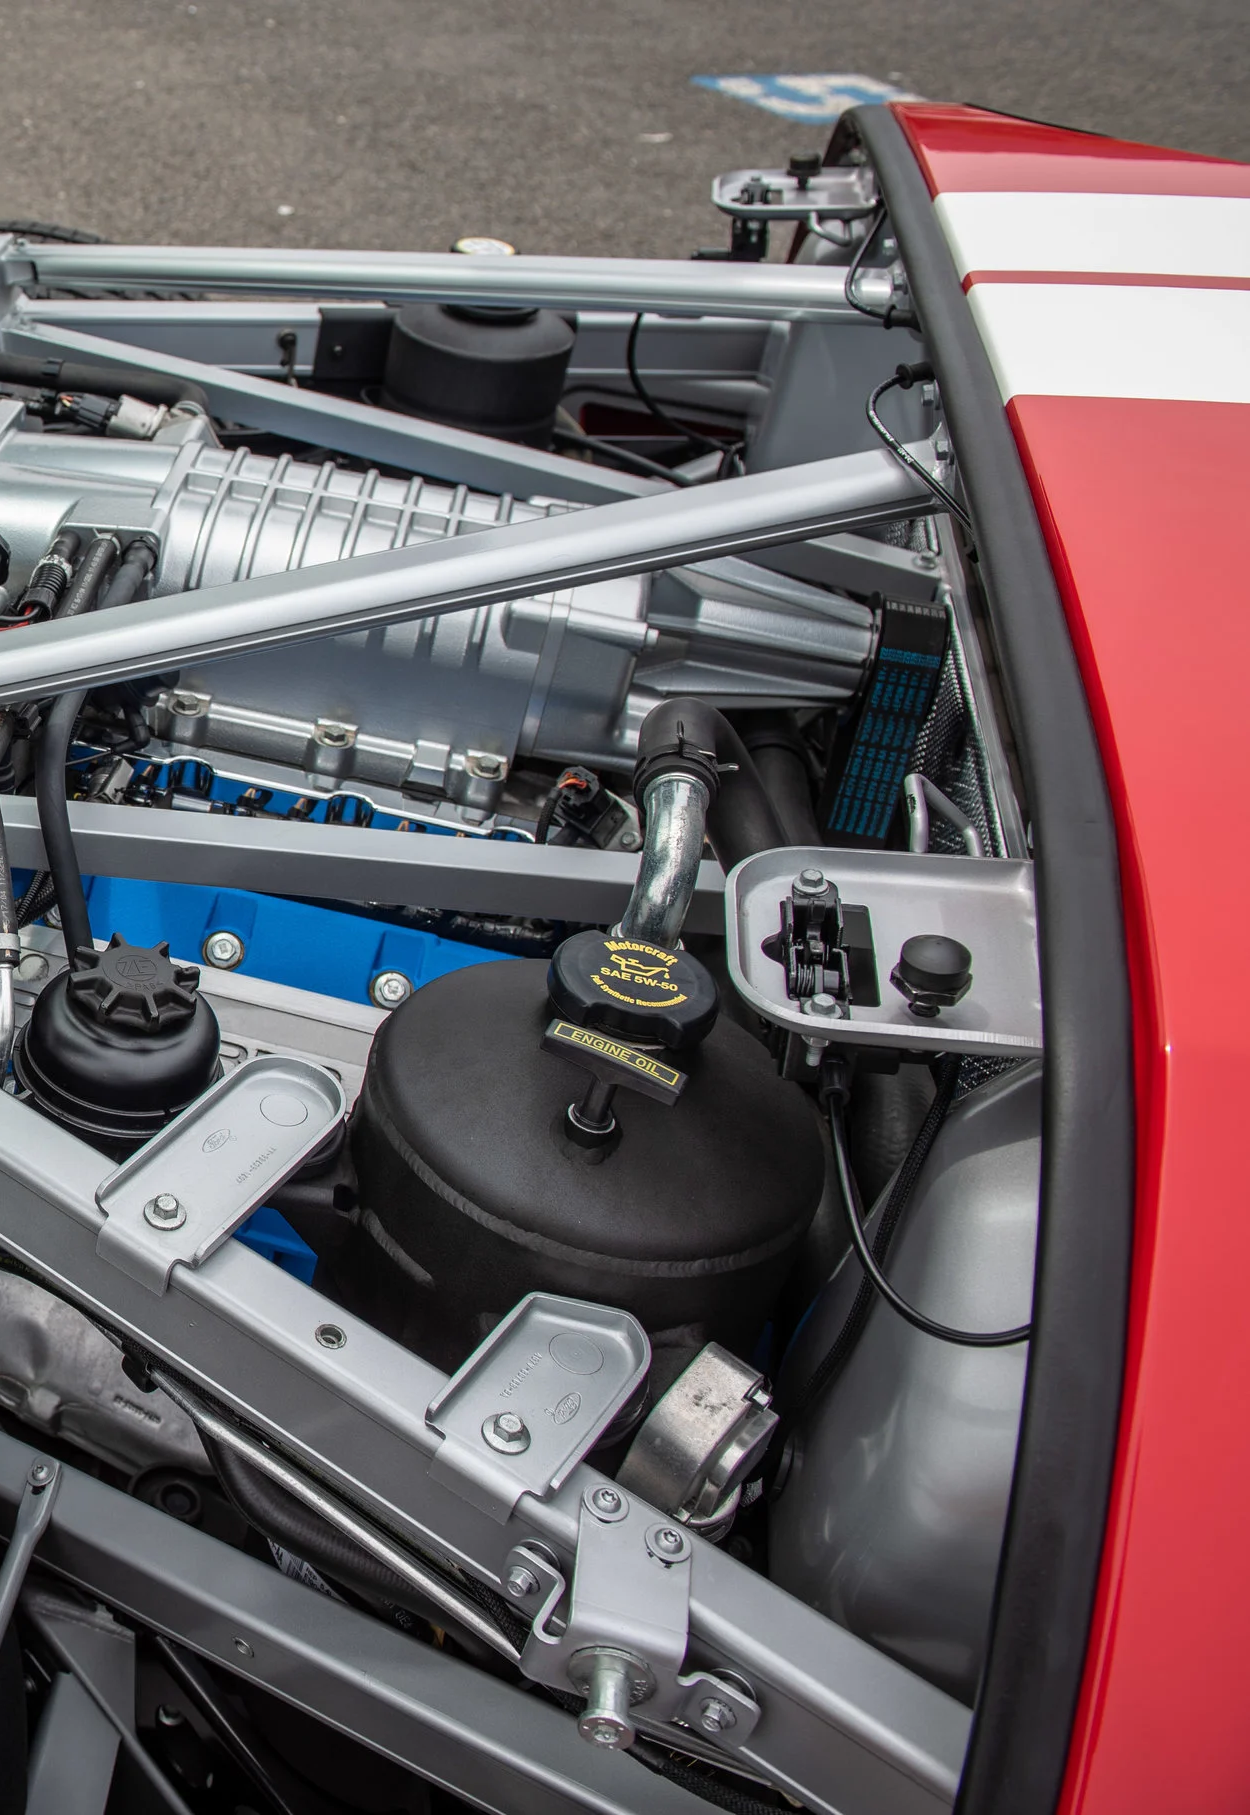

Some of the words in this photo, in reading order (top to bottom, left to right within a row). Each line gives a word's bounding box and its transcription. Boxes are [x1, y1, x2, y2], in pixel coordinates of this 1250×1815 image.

[604, 941, 678, 966] Motorcraft
[600, 967, 631, 981] SAE
[634, 975, 678, 992] 5W-50
[600, 984, 635, 1004] Synthetic
[571, 1031, 631, 1060] ENGINE
[635, 1058, 660, 1075] OIL
